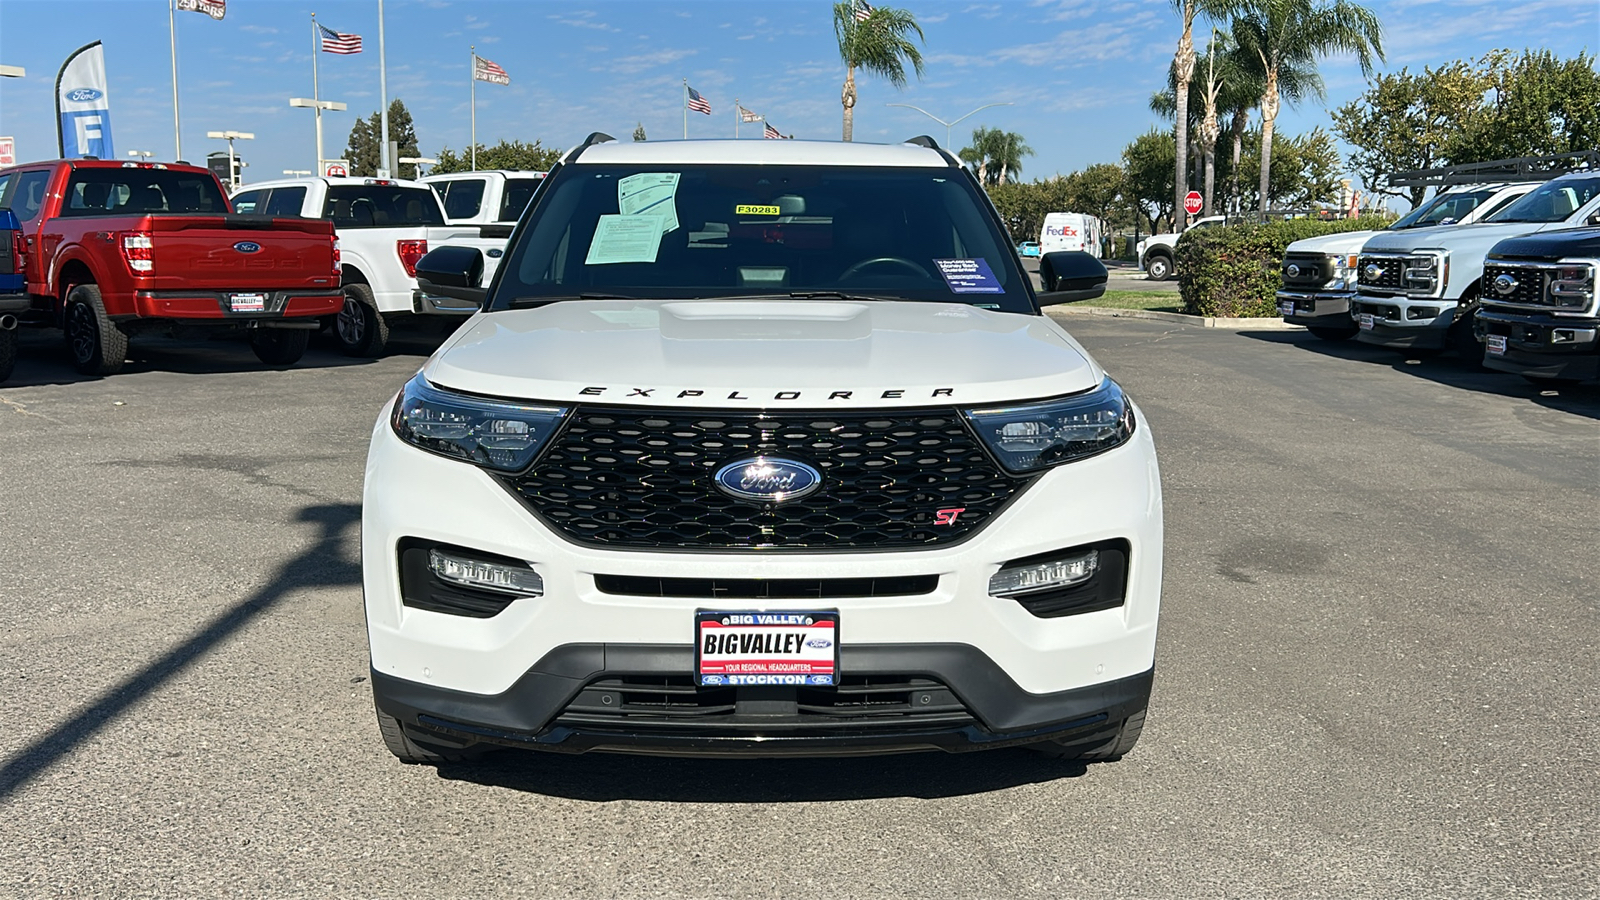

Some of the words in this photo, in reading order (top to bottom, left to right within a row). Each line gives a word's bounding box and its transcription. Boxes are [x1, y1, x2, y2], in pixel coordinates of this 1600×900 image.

[476, 72, 488, 80] 250
[488, 74, 509, 84] YEARS
[72, 89, 96, 101] Ford
[74, 115, 102, 154] F
[1185, 198, 1202, 208] STOP
[738, 206, 778, 214] F30283
[1046, 225, 1078, 237] FedEx
[578, 386, 954, 400] EXPLORER
[740, 464, 797, 490] Ford
[933, 507, 966, 525] ST
[730, 614, 754, 625] BIG
[756, 614, 805, 625] VALLEY
[703, 633, 807, 655] BIGVALLEY
[808, 639, 829, 648] Ford
[725, 664, 741, 672] YOUR
[741, 663, 768, 672] REGIONAL
[768, 663, 812, 672] HEADQUARTERS
[728, 674, 806, 685] STOCKTON
